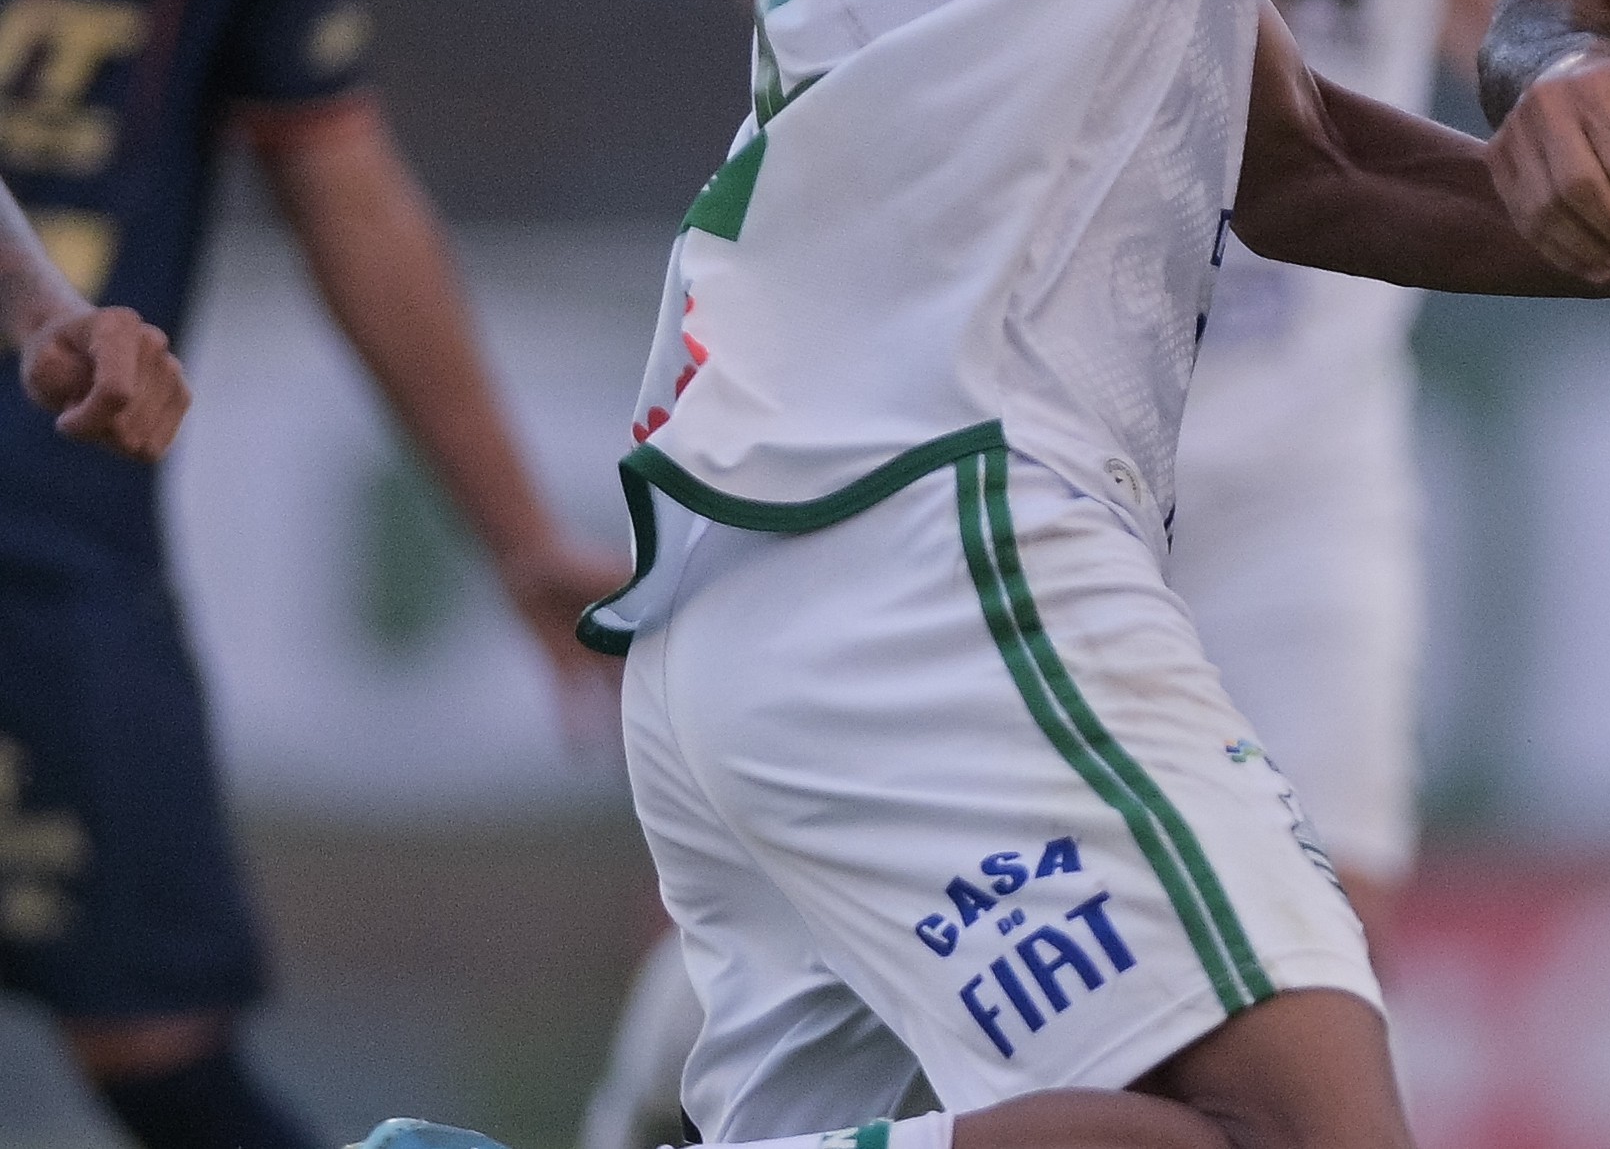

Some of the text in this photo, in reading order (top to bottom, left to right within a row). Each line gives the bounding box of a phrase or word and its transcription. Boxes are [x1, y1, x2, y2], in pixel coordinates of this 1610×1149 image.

[915, 835, 1083, 957] CASA
[996, 907, 1026, 936] DO
[959, 890, 1137, 1059] FIAT
